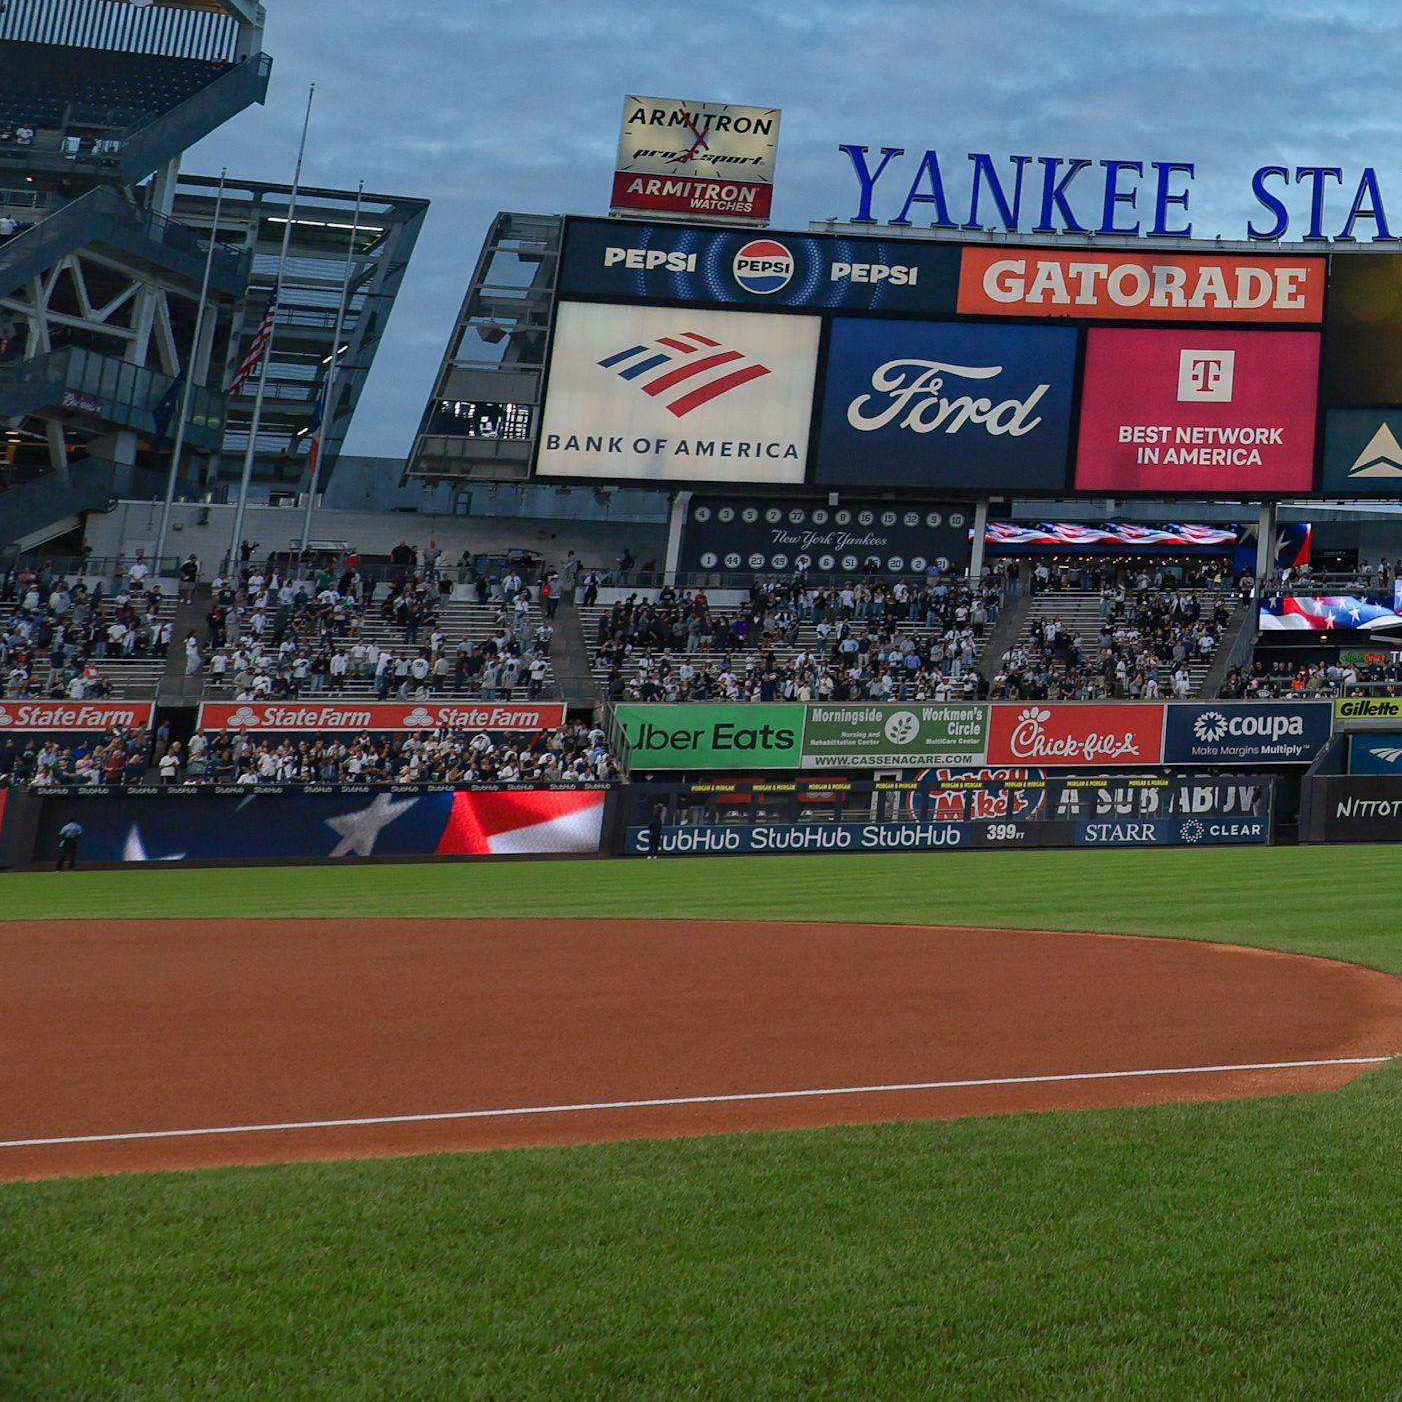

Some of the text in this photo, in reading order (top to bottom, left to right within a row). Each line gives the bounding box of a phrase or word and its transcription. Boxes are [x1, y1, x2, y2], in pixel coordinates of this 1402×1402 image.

[628, 108, 773, 136] ARMITRON
[627, 177, 756, 203] ARMITRON
[839, 143, 1195, 239] YANKEE
[689, 198, 753, 213] WATCHES
[604, 247, 698, 273] PEPSI
[736, 260, 791, 275] PEPSI
[831, 261, 918, 286] PEPSI
[982, 259, 1307, 309] GATORADE
[847, 358, 1051, 437] Ford
[1118, 425, 1284, 446] BEST NETWORK
[547, 434, 799, 460] BANK OF AMERICA
[1137, 446, 1263, 466] IN AMERICA
[771, 529, 888, 551] New York Yankees
[14, 706, 135, 726] StateFarm
[261, 707, 372, 726] StateFarm
[811, 708, 883, 726] Morningside
[922, 706, 983, 721] Workmen's
[1340, 700, 1399, 716] Gillette
[621, 722, 795, 751] Uber Eats
[840, 731, 867, 740] Nursing
[947, 722, 981, 736] Circle
[1010, 716, 1140, 761] Chick-fil-A
[1228, 716, 1304, 742] coupa
[810, 738, 880, 746] Rehabilitation Center
[1191, 746, 1218, 756] Make
[1220, 745, 1260, 757] Margins
[815, 755, 973, 766] WWW.CASSENACARE.COM
[636, 828, 740, 852] SubHub
[750, 827, 851, 850] StubHub
[861, 825, 961, 847] StubHub
[1085, 823, 1157, 842] STARR
[1209, 825, 1262, 837] CLEAR
